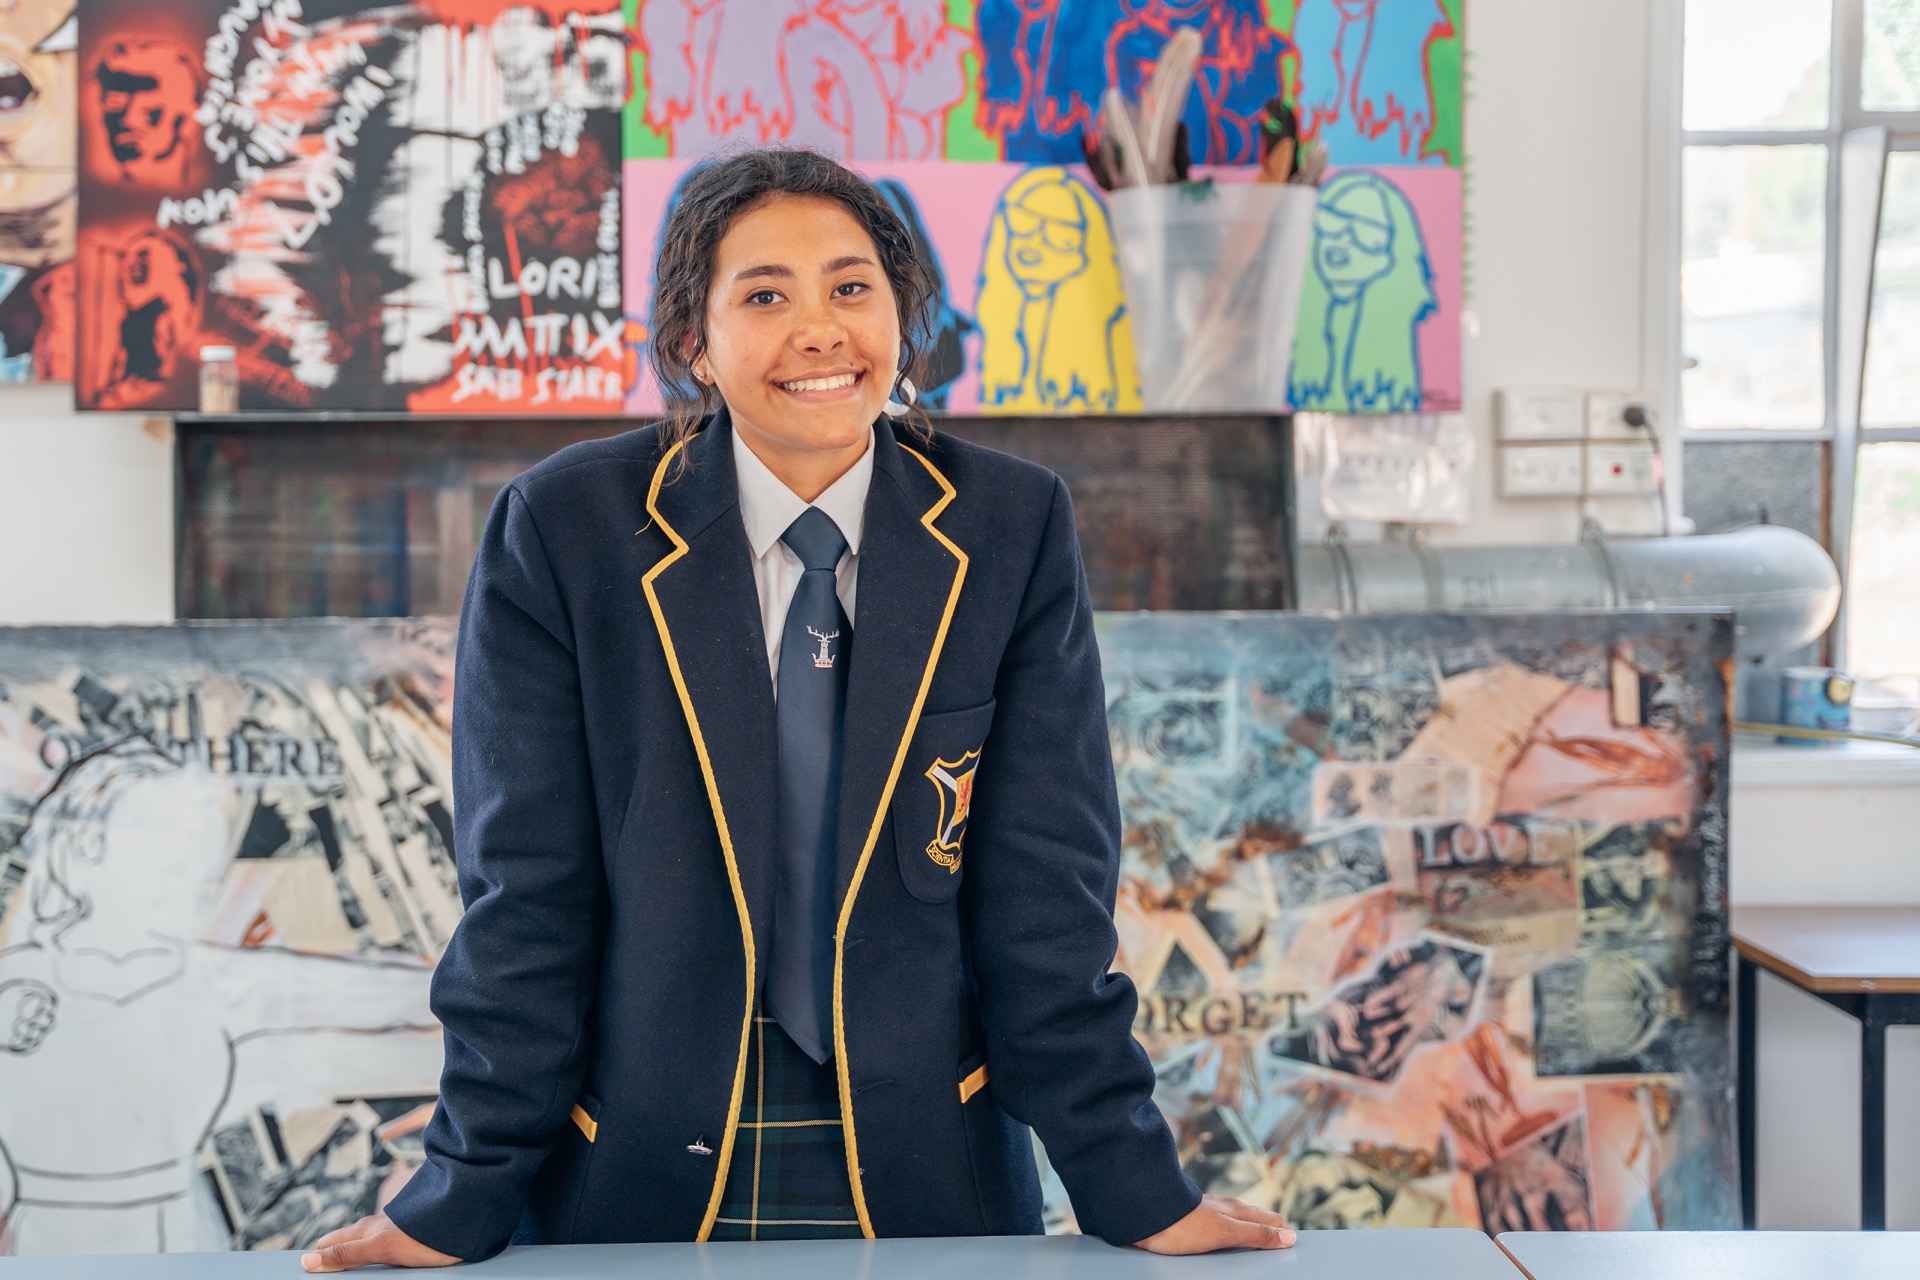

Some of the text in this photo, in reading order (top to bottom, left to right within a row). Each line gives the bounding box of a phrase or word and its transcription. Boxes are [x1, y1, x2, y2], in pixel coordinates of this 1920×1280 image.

[487, 256, 598, 300] LORI
[1418, 820, 1560, 867] LOVE
[1137, 989, 1308, 1035] ORGET
